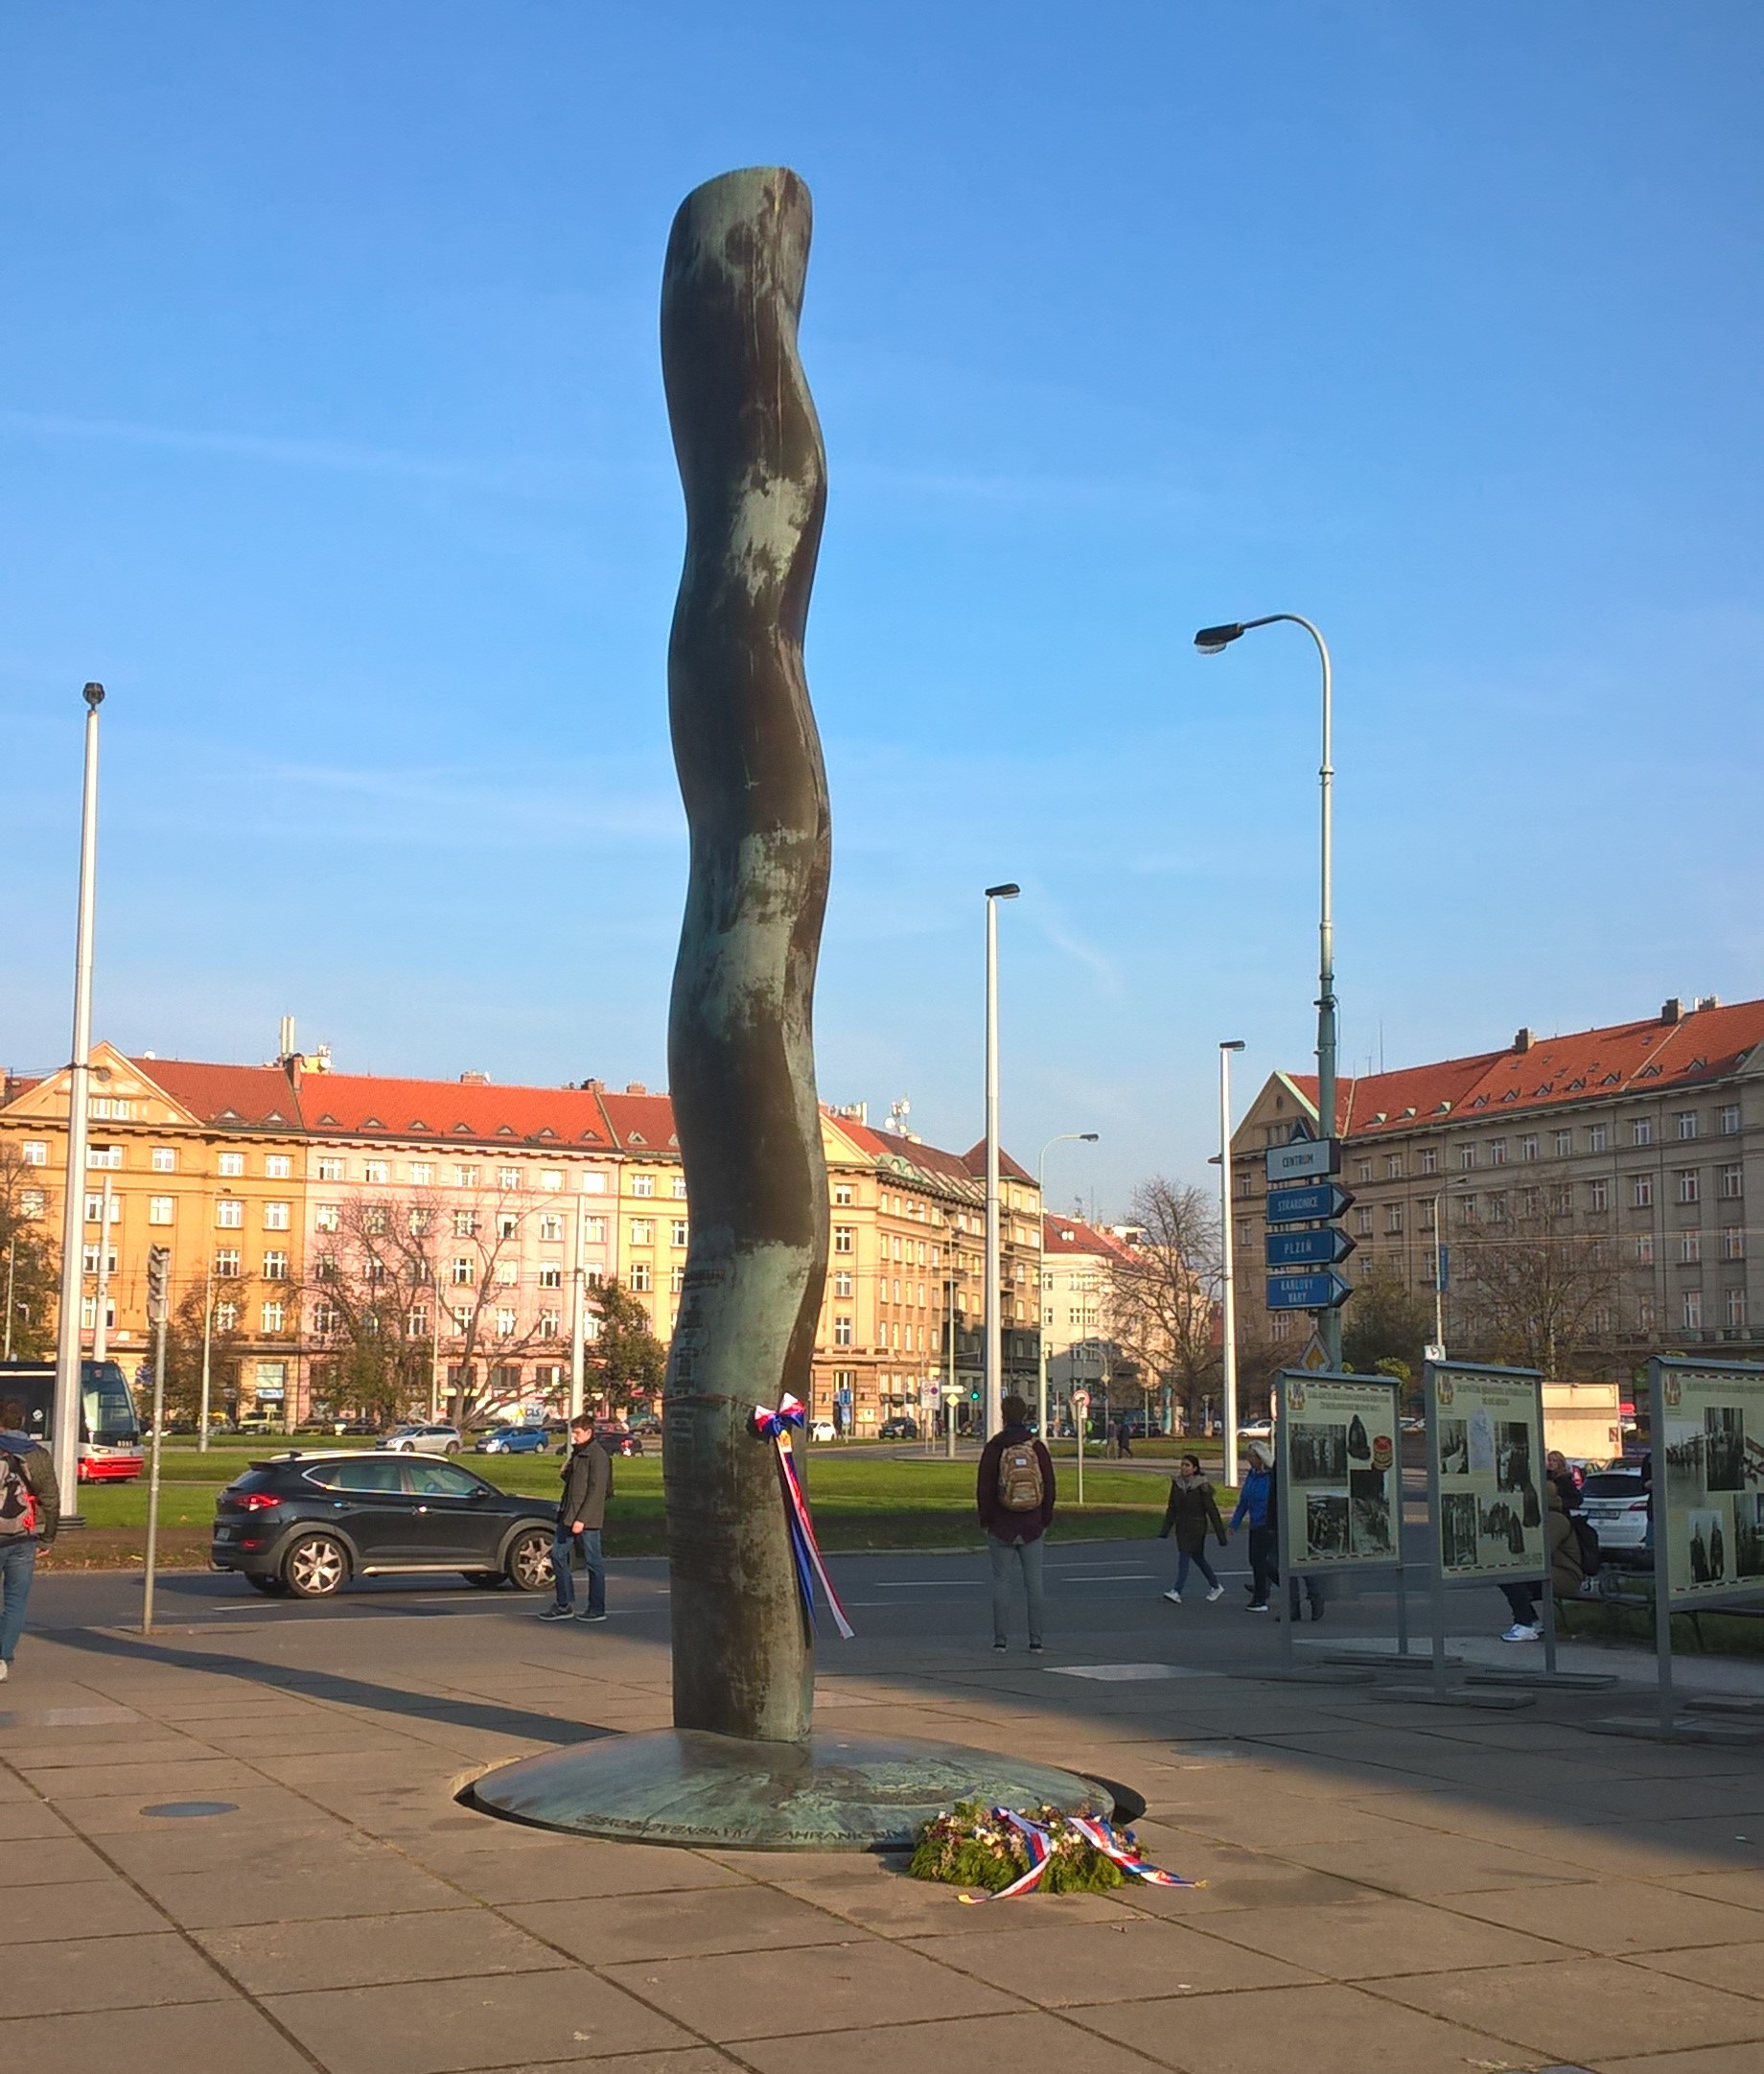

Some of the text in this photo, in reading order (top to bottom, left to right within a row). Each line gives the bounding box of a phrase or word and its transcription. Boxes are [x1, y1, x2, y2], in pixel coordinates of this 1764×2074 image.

[1282, 1154, 1313, 1168] CENTRUM
[1278, 1196, 1318, 1212] STRAKONICE
[1284, 1239, 1312, 1254] PLZEŇ
[1281, 1279, 1313, 1291] KARLOVY
[1288, 1292, 1307, 1303] VARY
